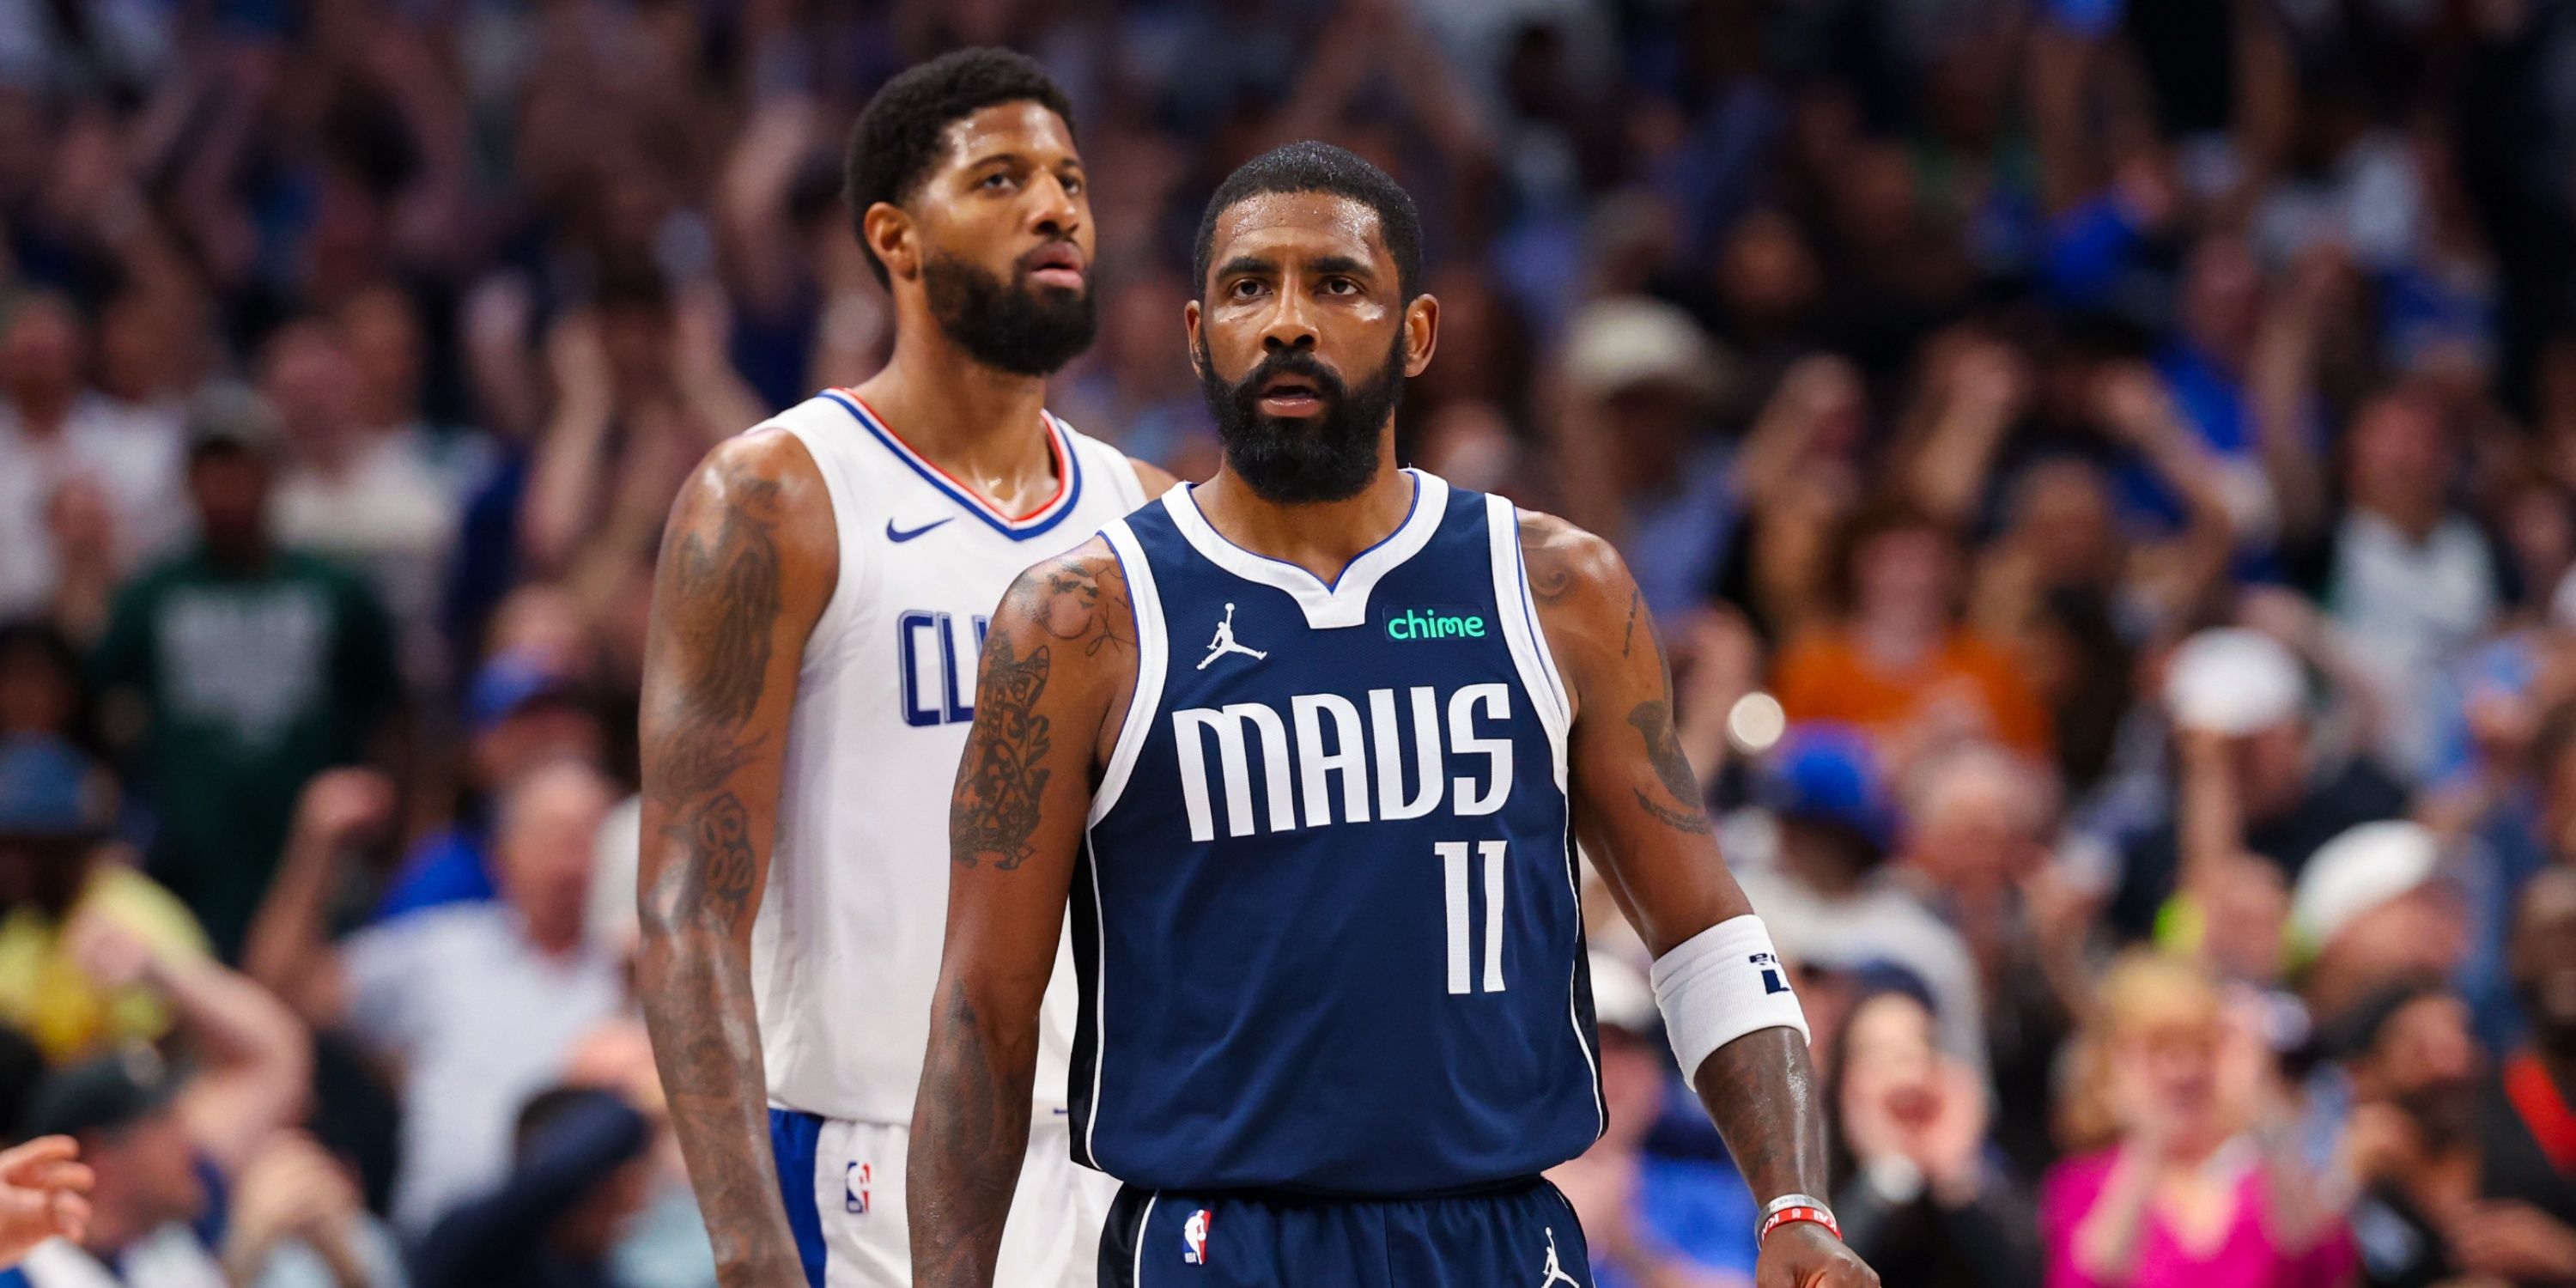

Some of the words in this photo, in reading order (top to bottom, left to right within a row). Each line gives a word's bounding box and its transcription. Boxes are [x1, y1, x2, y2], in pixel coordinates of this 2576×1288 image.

[1388, 609, 1485, 640] chime
[1172, 683, 1513, 841] MAVS
[1434, 840, 1508, 994] 11
